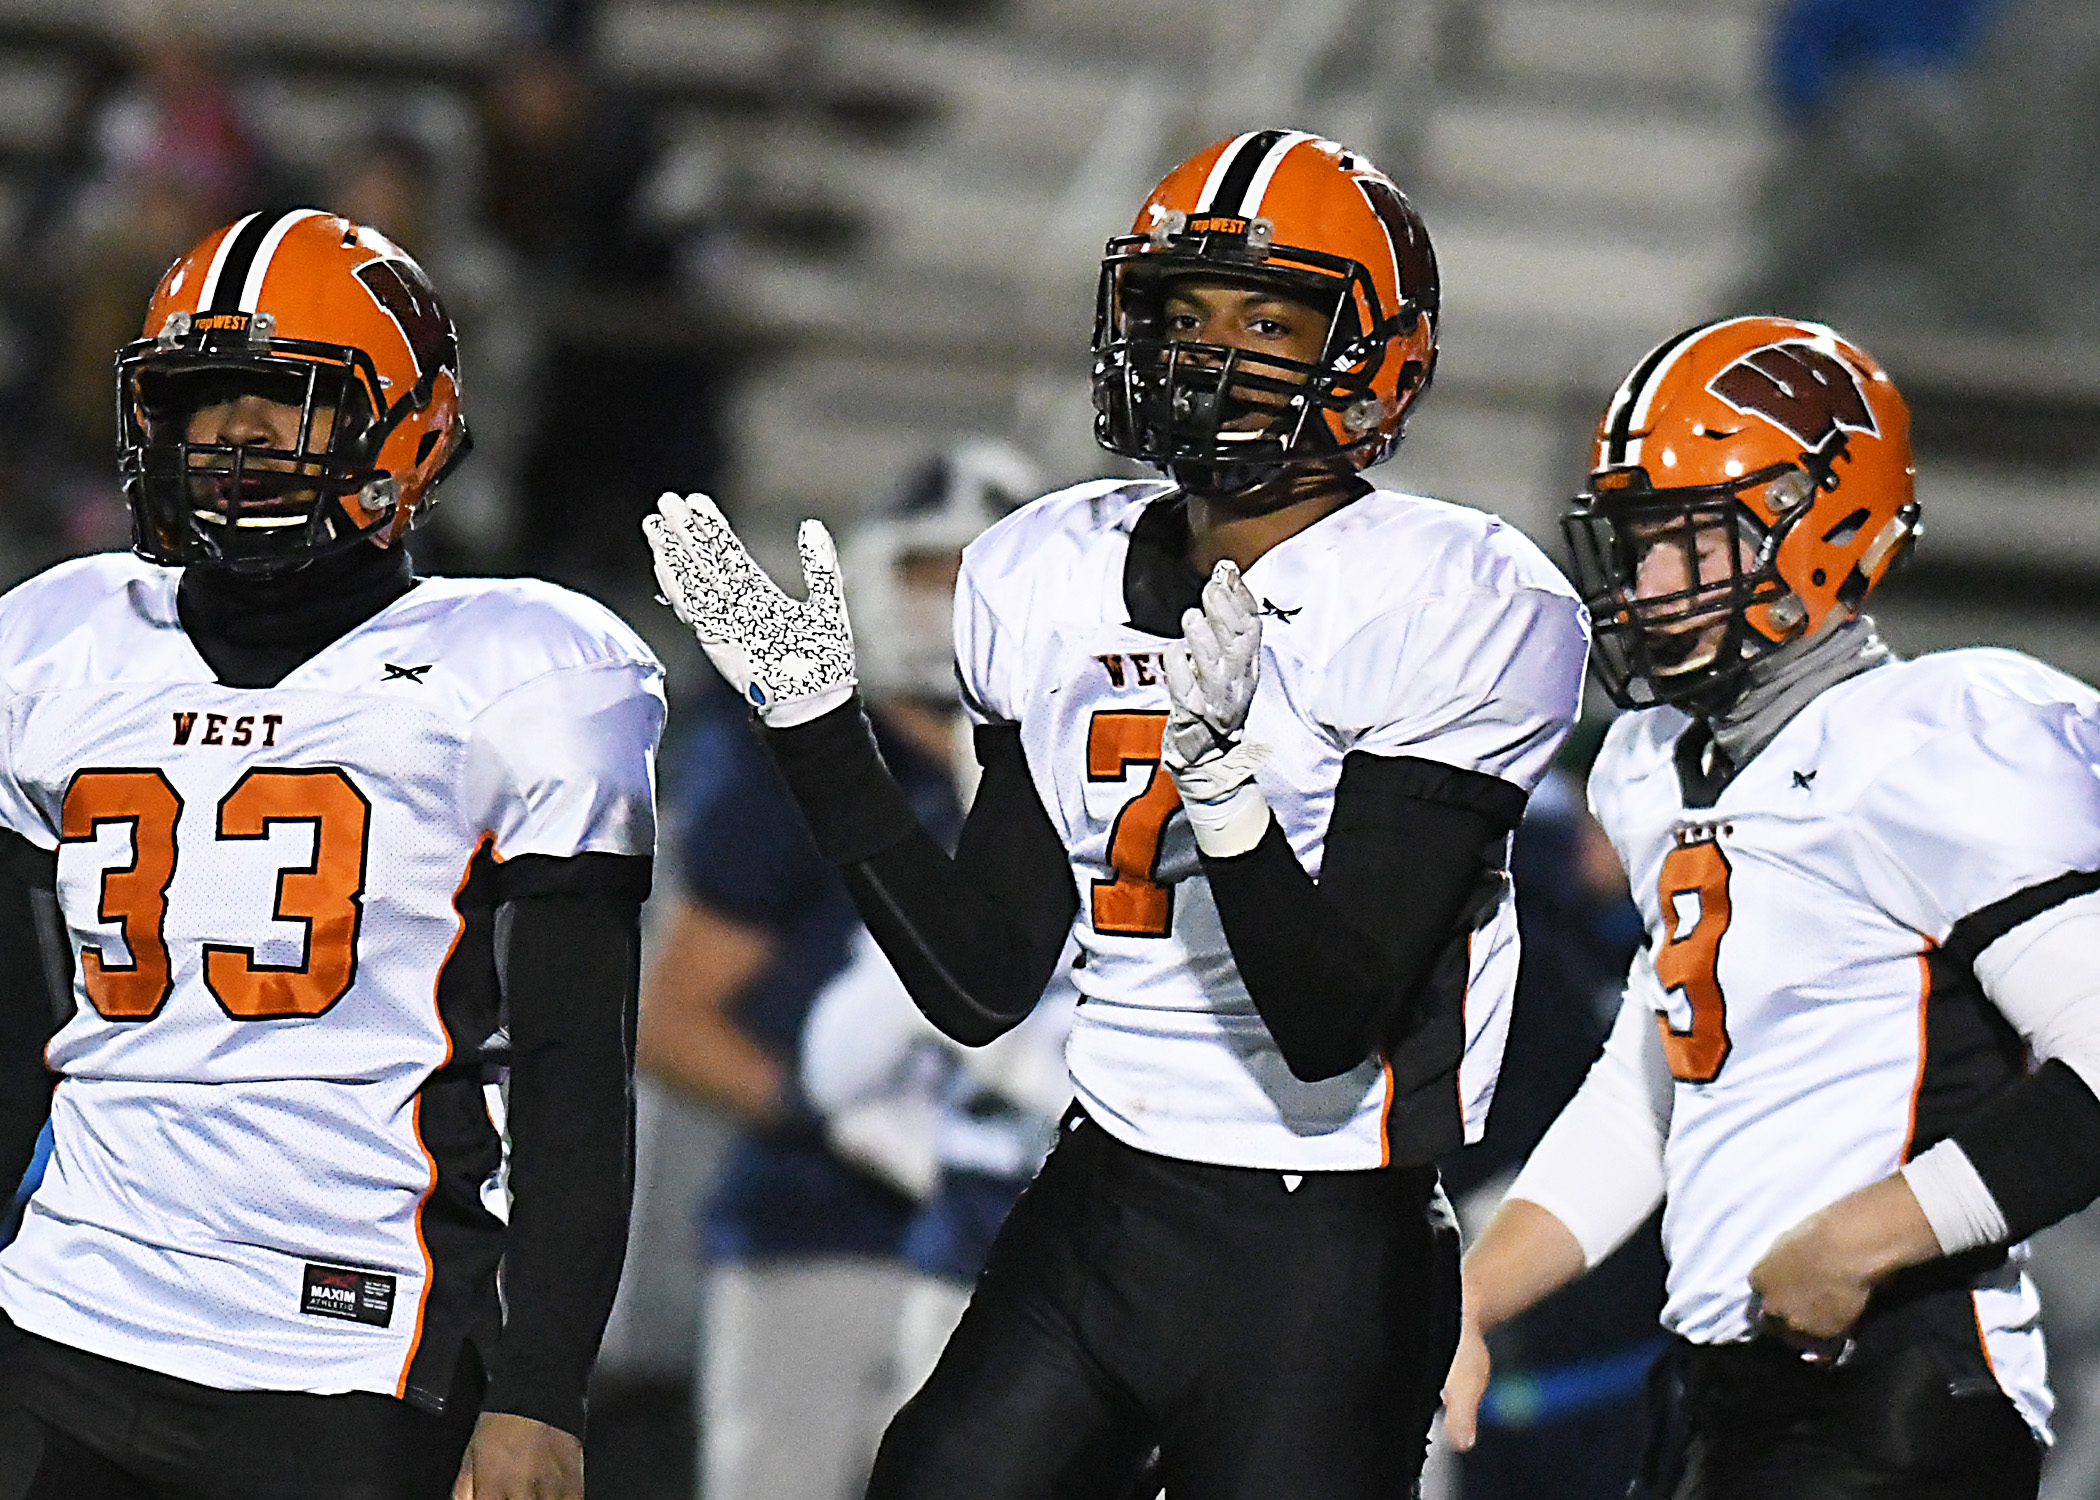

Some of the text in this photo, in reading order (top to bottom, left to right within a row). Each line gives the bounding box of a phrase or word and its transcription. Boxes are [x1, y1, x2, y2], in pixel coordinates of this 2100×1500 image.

[172, 711, 283, 746] WEST
[1086, 708, 1183, 939] 7
[60, 765, 372, 1022] 33
[1655, 838, 1733, 1085] 9
[309, 1298, 354, 1311] ATHLETIC
[310, 1285, 356, 1304] MAXIM
